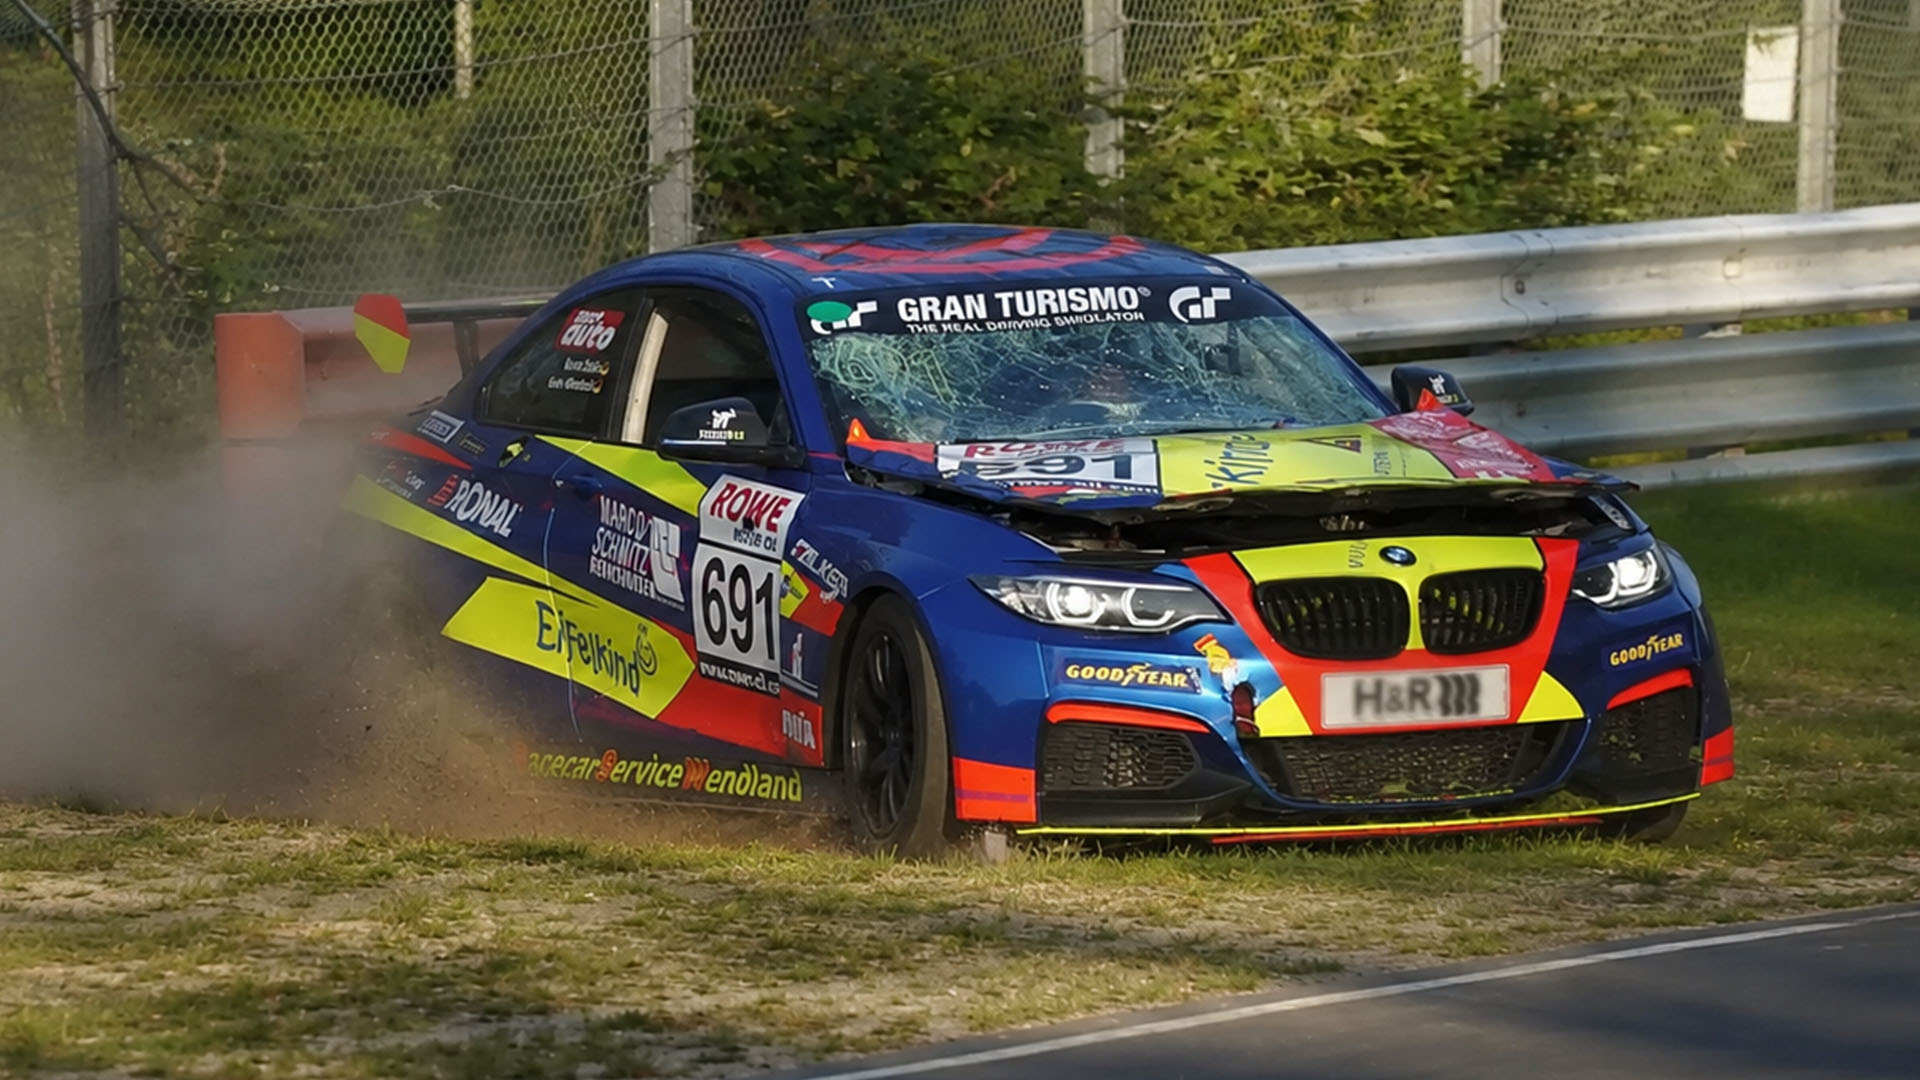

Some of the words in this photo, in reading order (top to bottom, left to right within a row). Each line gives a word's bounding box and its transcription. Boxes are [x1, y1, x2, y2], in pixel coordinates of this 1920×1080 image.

[896, 293, 988, 322] GRAN
[1169, 286, 1231, 323] GT
[443, 478, 520, 538] RONAL
[599, 494, 648, 542] MARCO
[709, 482, 793, 533] ROWE
[591, 526, 650, 577] SCHMITZ
[702, 556, 775, 661] 691
[535, 600, 640, 697] Eifelkind
[1609, 633, 1684, 666] GOODYEAR
[1065, 662, 1189, 687] GOODYEAR
